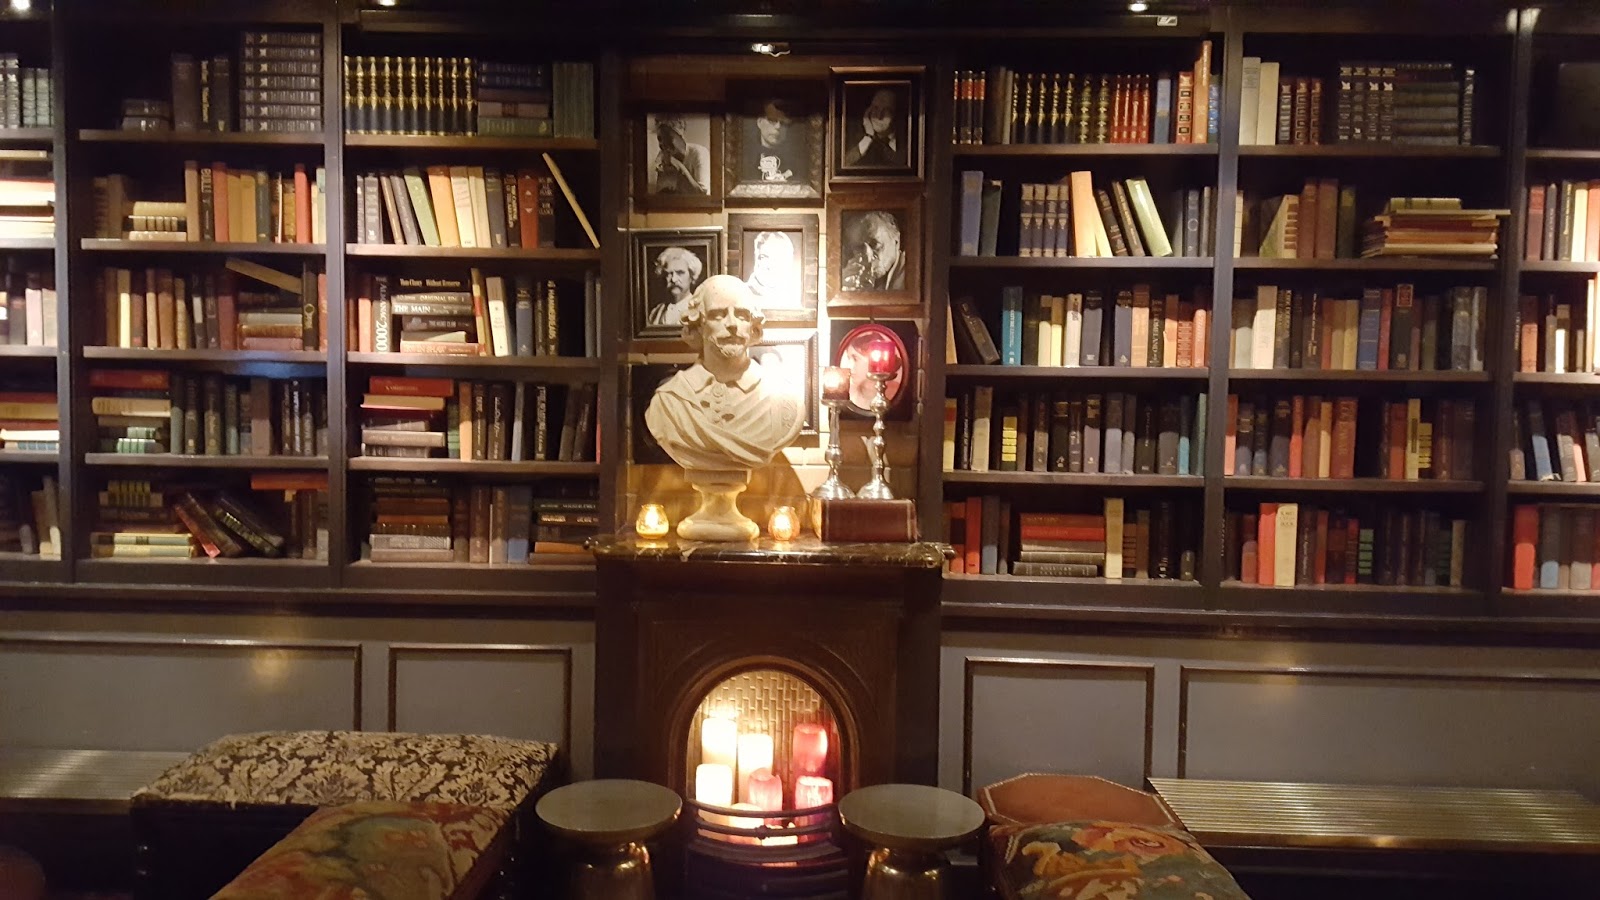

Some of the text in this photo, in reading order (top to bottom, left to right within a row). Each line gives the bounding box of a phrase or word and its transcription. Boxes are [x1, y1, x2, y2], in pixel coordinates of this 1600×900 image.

[394, 304, 409, 313] THE
[410, 305, 431, 314] MAIN
[375, 321, 388, 351] 2000
